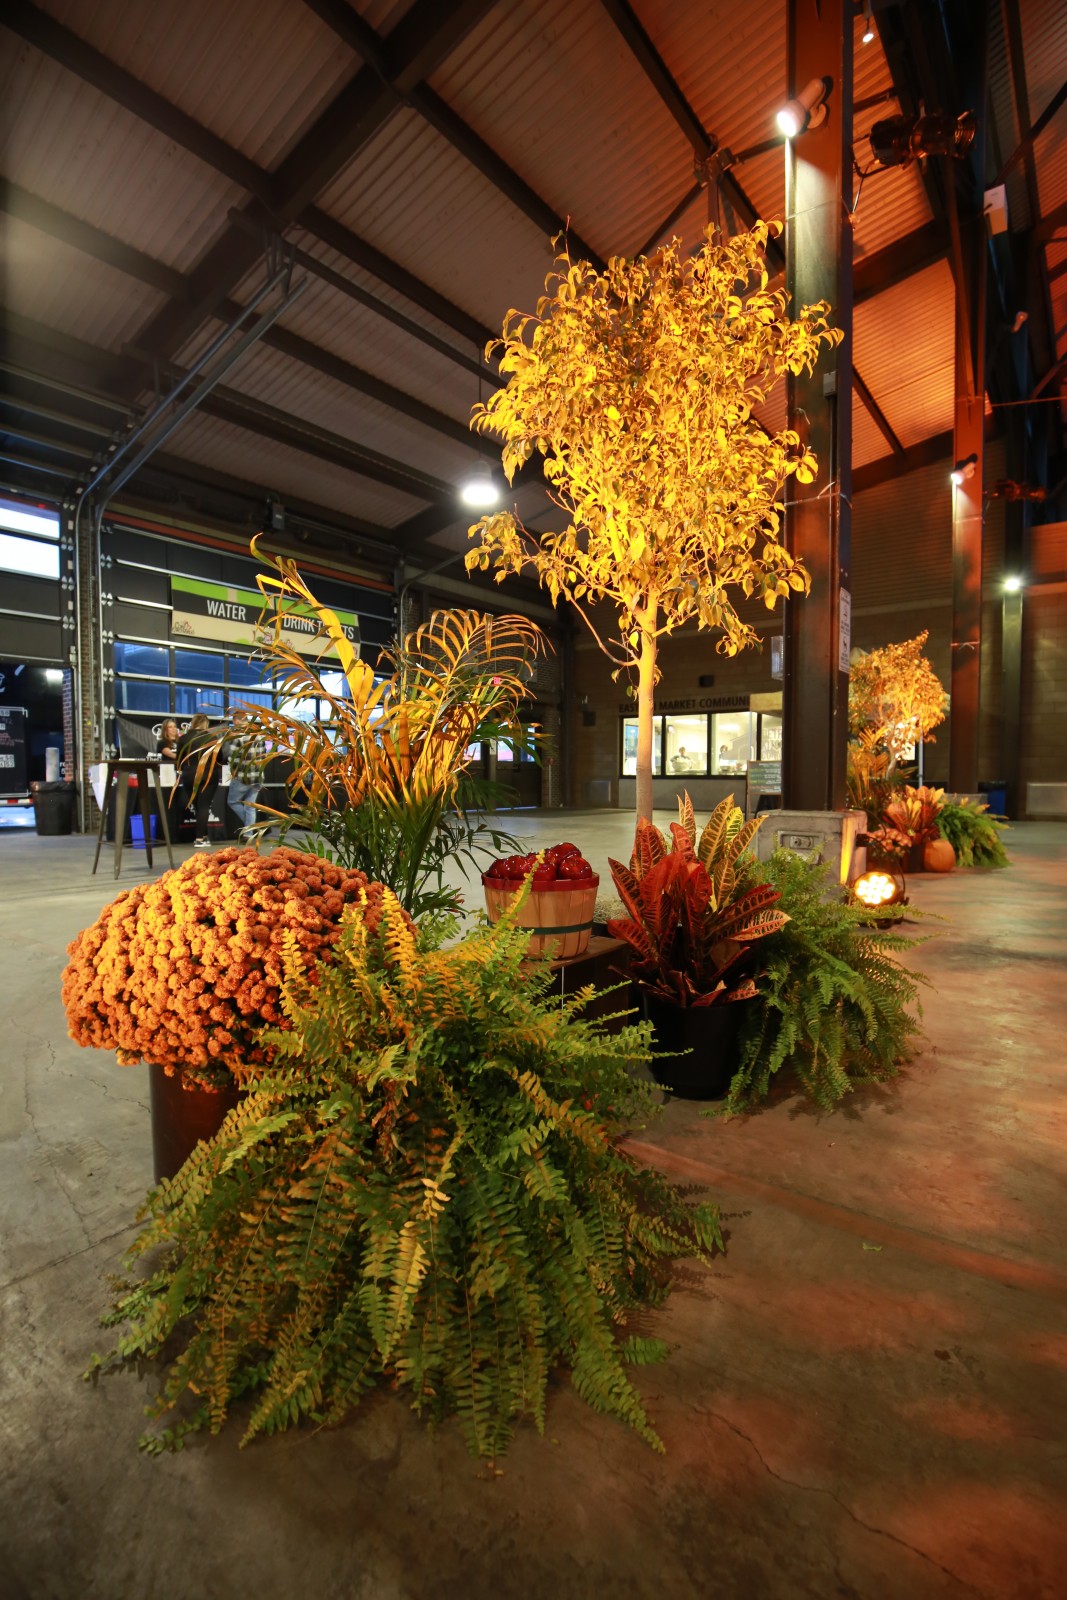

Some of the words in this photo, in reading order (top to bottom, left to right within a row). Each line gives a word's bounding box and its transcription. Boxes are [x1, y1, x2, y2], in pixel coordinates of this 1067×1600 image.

[206, 599, 246, 621] WATER
[283, 613, 315, 633] DRINK
[659, 699, 696, 710] MARKET
